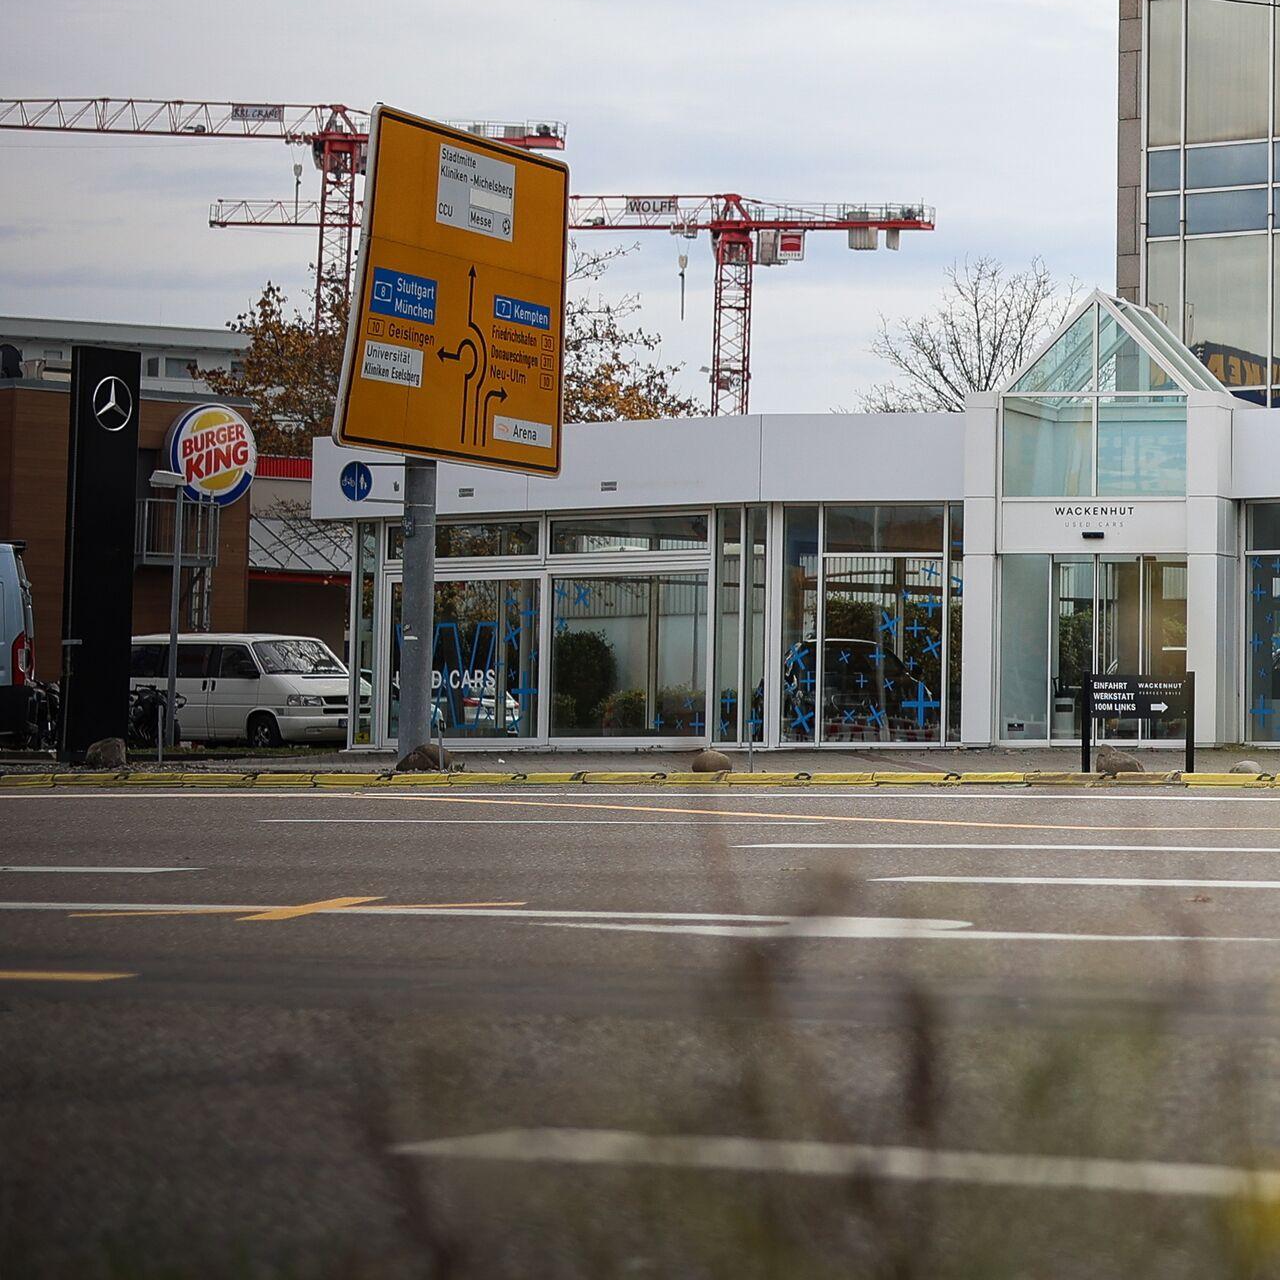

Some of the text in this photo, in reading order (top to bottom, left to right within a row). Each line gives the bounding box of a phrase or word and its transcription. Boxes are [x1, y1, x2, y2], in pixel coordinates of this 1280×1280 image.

[441, 147, 477, 169] Stadtmitte
[440, 164, 468, 184] Kliniken
[438, 202, 454, 217] CCU
[629, 200, 676, 213] WOLFF
[470, 211, 492, 228] Messe
[396, 277, 435, 300] Stuttgart
[394, 298, 434, 320] München
[513, 304, 549, 326] Kempten
[372, 321, 435, 347] 10 Geislingen
[491, 325, 538, 347] Friedrichshafen
[366, 343, 411, 365] Universität
[491, 344, 539, 369] Donaueschingen
[364, 361, 420, 386] Kliniken Eselsberg
[489, 367, 527, 386] Neu-Ulm
[182, 423, 246, 458] BURGER
[512, 424, 537, 441] Arena
[185, 440, 249, 484] KING
[1055, 506, 1135, 516] WACKENHUT
[450, 669, 496, 689] CARS
[1093, 682, 1128, 690] EINFAHRT
[1095, 703, 1136, 711] 100M LINKS
